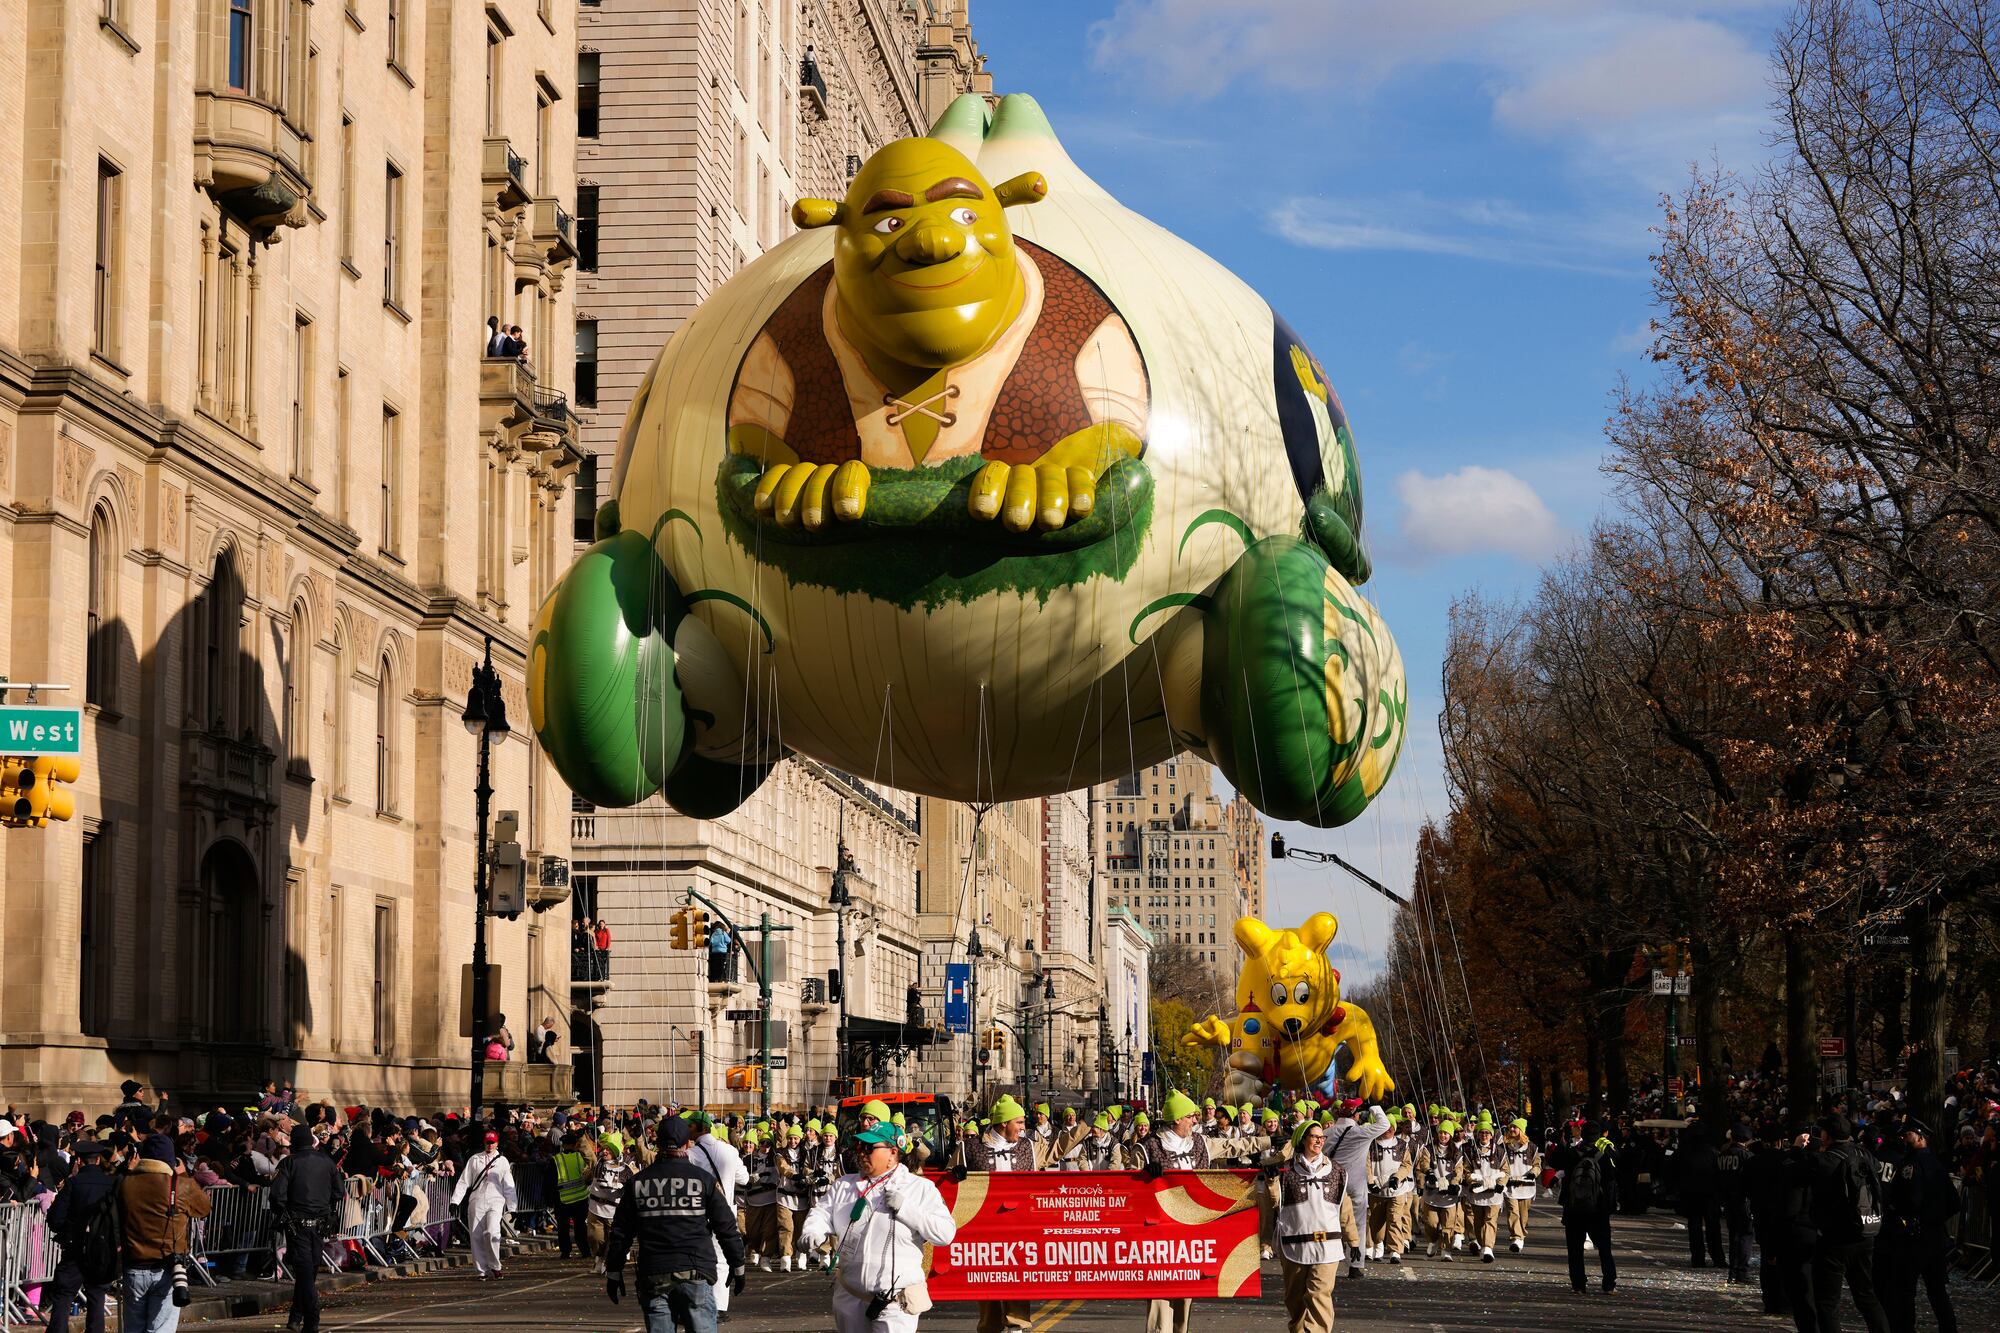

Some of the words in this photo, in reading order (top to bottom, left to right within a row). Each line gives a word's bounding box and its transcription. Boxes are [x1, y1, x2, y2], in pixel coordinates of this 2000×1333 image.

[9, 719, 74, 741] West
[1655, 982, 1669, 990] CARS
[1716, 1154, 1740, 1171] NYPD
[634, 1177, 704, 1197] NYPD
[1068, 1183, 1103, 1196] macy's
[636, 1196, 703, 1209] POLICE
[1036, 1196, 1106, 1209] THANKSGIVING
[1108, 1196, 1127, 1208] DAY
[1063, 1210, 1101, 1222] PARADE
[1043, 1227, 1121, 1235] PRESENTS
[950, 1240, 1038, 1266] SHREK'S
[1044, 1241, 1108, 1266] ONION
[1114, 1239, 1218, 1265] CARRIAGE
[967, 1271, 1021, 1283] UNIVERSAL
[1023, 1270, 1072, 1282] PICTURES'
[1075, 1269, 1144, 1282] DREAMWORKS
[1147, 1269, 1201, 1281] ANIMATION
